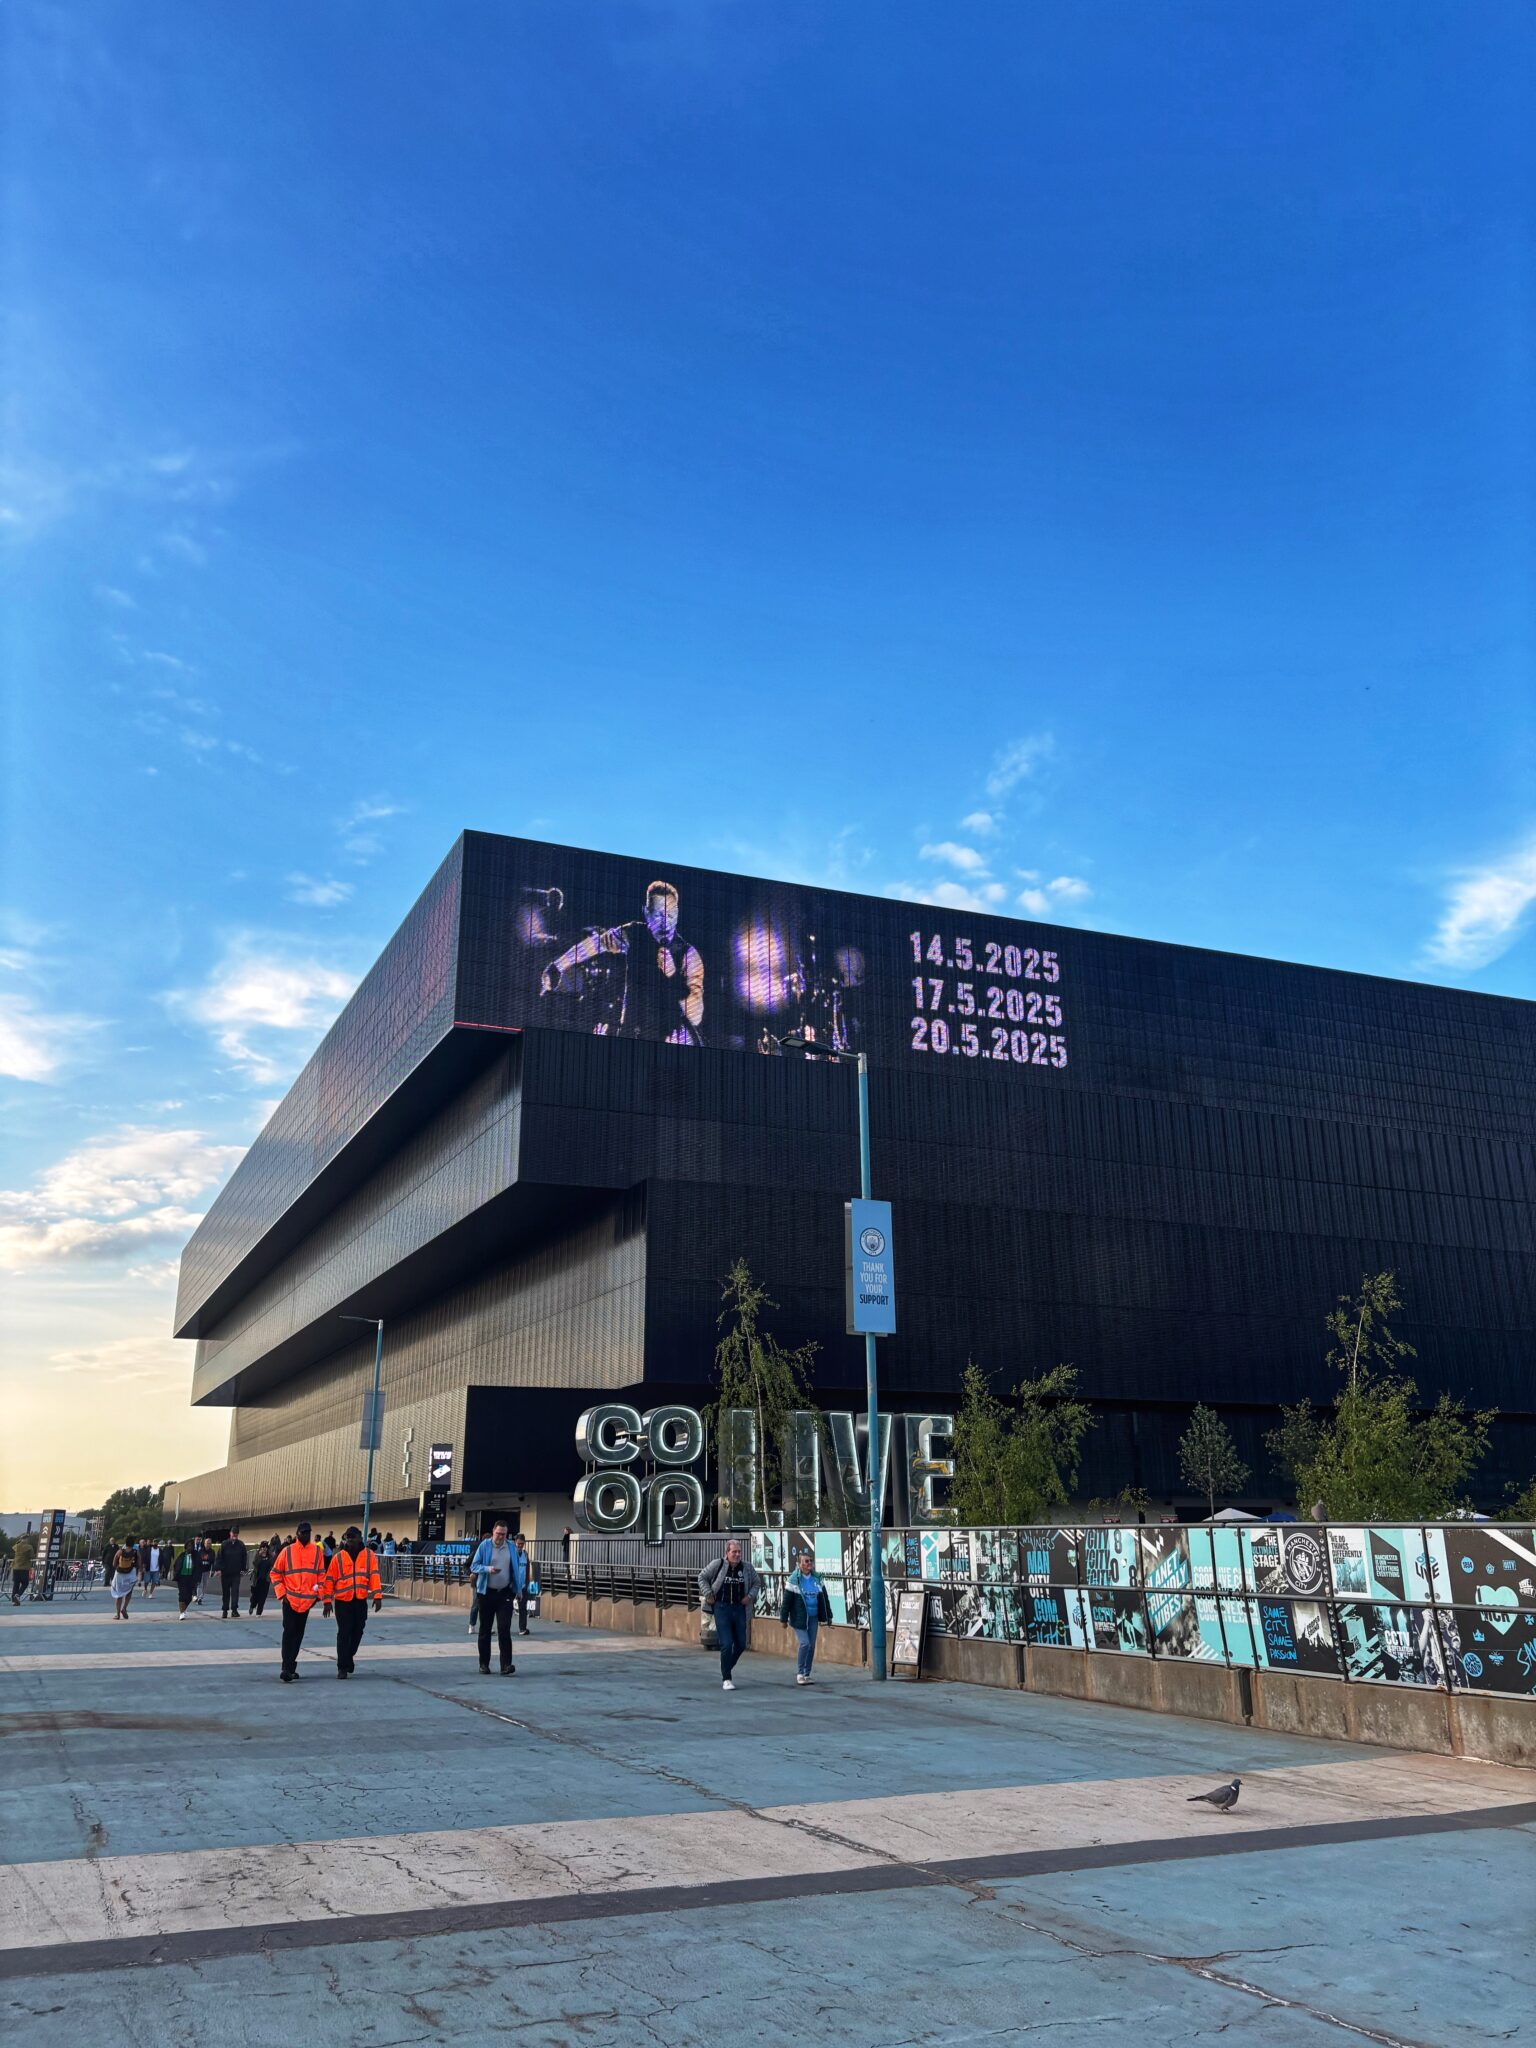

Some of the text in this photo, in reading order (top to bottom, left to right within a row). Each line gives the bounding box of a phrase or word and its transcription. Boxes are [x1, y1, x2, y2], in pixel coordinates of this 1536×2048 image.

[909, 931, 1060, 983] 14.5.2025
[911, 976, 1063, 1027] 17.5.2025
[910, 1016, 1068, 1068] 20.5.2025
[862, 1261, 884, 1273] THANK
[860, 1271, 888, 1284] YOU FOR
[864, 1283, 883, 1294] YOUR
[859, 1294, 889, 1306] SUPPORT
[718, 1408, 959, 1529] LIVE
[1264, 1536, 1277, 1546] THE
[1331, 1542, 1349, 1550] THINGS
[435, 1544, 471, 1555] SEATING
[953, 1543, 969, 1558] THE
[1252, 1546, 1278, 1555] ULTIMATE
[1286, 1537, 1320, 1562] MANCHESTER
[1332, 1550, 1363, 1558] DIFFERENTLY
[939, 1558, 970, 1571] ULTMATE
[1026, 1550, 1051, 1574] MAN
[1253, 1555, 1280, 1567] STAGE
[940, 1571, 970, 1591] STAGE
[1028, 1574, 1050, 1599] CITY
[1294, 1580, 1308, 1590] CITY
[1147, 1563, 1186, 1616] RIENDLY
[1153, 1596, 1181, 1632] VIBES
[1262, 1606, 1288, 1619] SAME
[1264, 1619, 1289, 1634] CITY
[1267, 1633, 1293, 1647] SAME
[1384, 1630, 1410, 1646] CCTV
